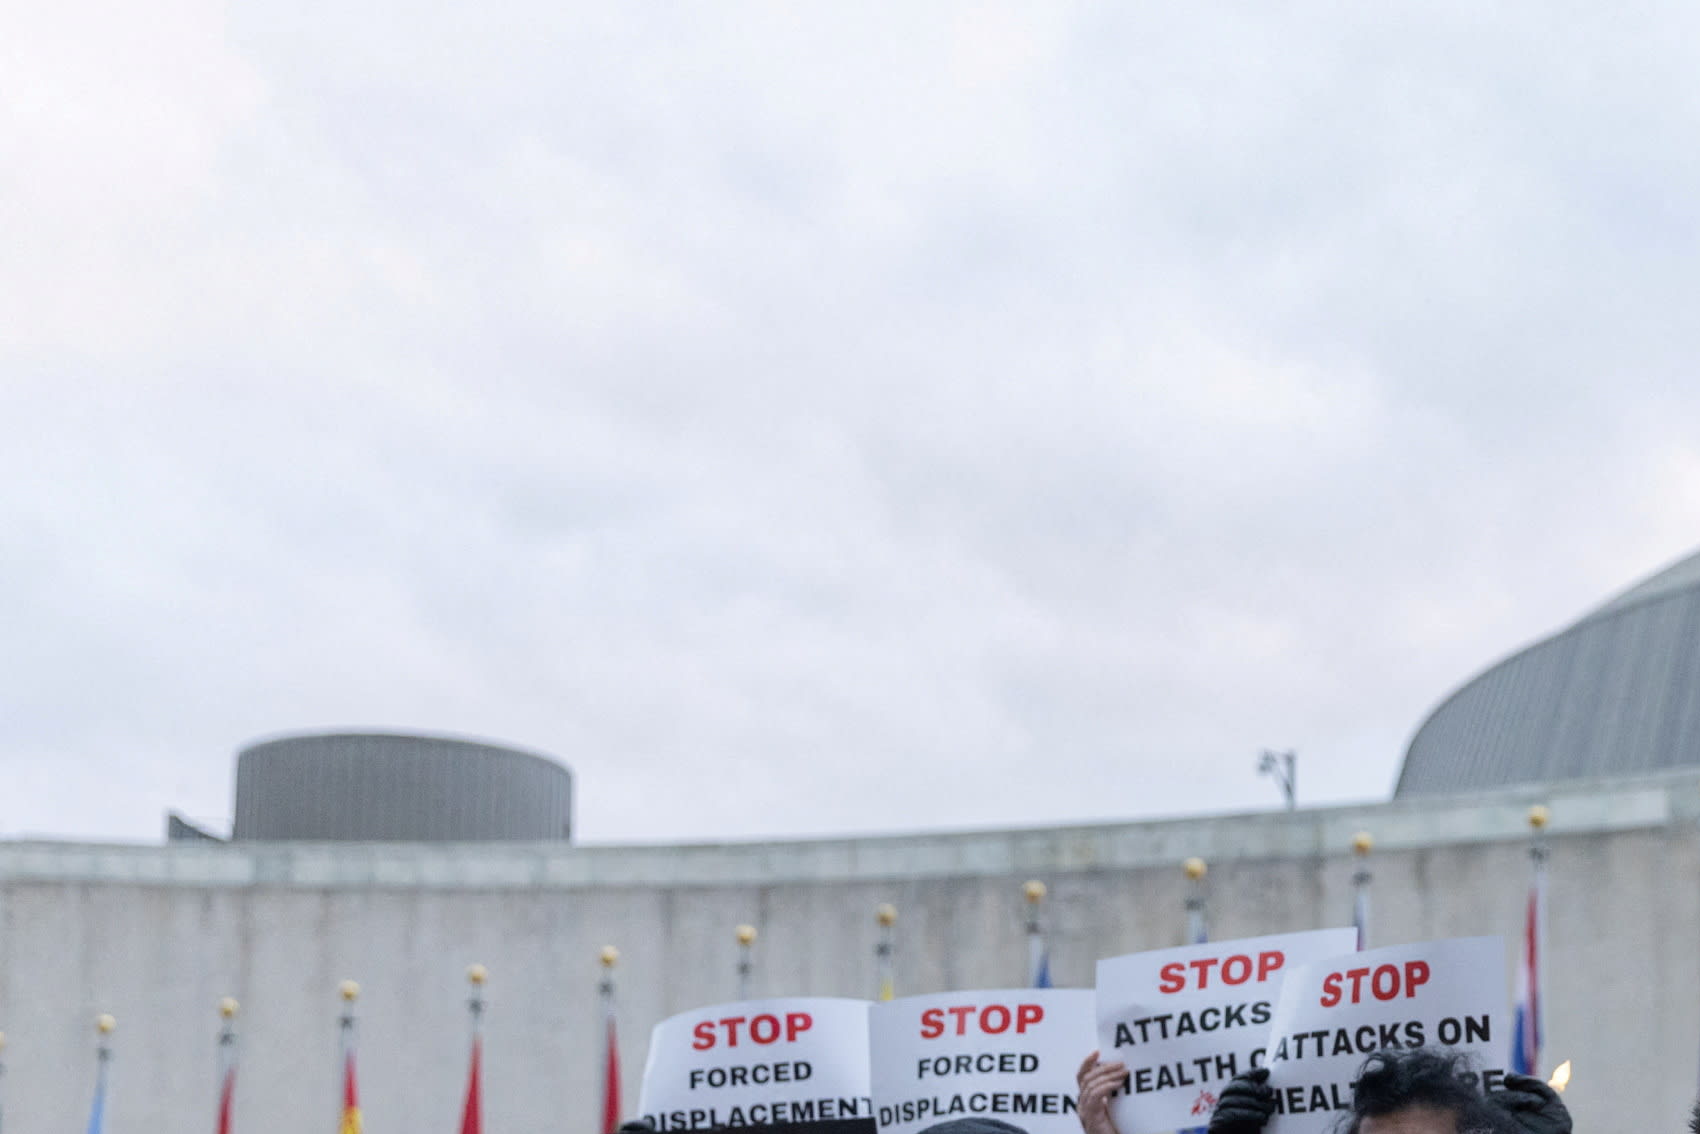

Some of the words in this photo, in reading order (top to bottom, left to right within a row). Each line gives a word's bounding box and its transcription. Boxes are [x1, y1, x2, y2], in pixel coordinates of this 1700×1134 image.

[1159, 951, 1285, 994] STOP
[1320, 960, 1430, 1008] STOP
[692, 1012, 813, 1051] STOP
[920, 1004, 1044, 1039] STOP
[1115, 1001, 1272, 1049] ATTACKS
[1272, 1020, 1425, 1062] ATTACKS
[1438, 1014, 1490, 1046] ON
[689, 1061, 812, 1090] FORCED
[917, 1053, 1039, 1080] FORCED
[880, 1093, 1079, 1127] DISPLACEMEN
[1272, 1081, 1358, 1115] HEAL
